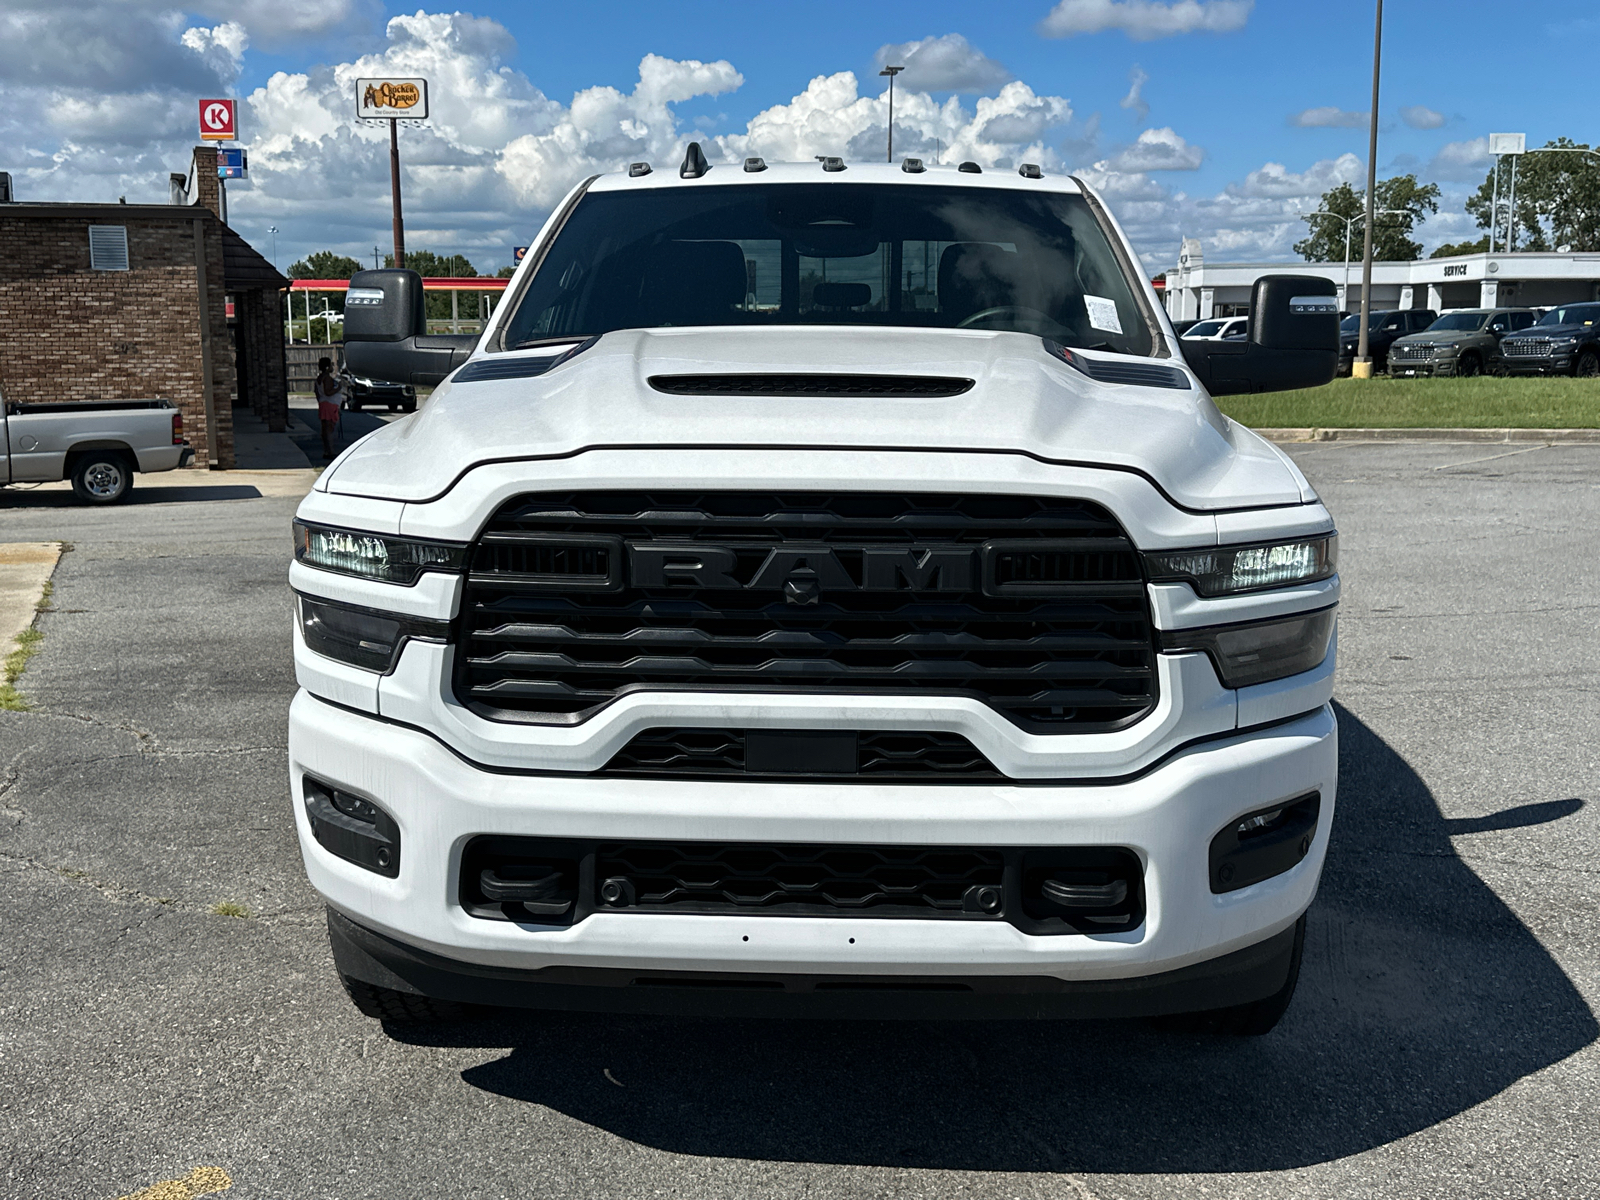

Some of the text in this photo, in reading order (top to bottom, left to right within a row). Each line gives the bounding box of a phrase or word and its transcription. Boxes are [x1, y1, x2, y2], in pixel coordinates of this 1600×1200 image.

[381, 83, 415, 97] Cracker
[389, 93, 417, 107] Barrel
[211, 109, 227, 127] K
[1443, 264, 1467, 277] SERVICE
[631, 544, 977, 592] RAM
